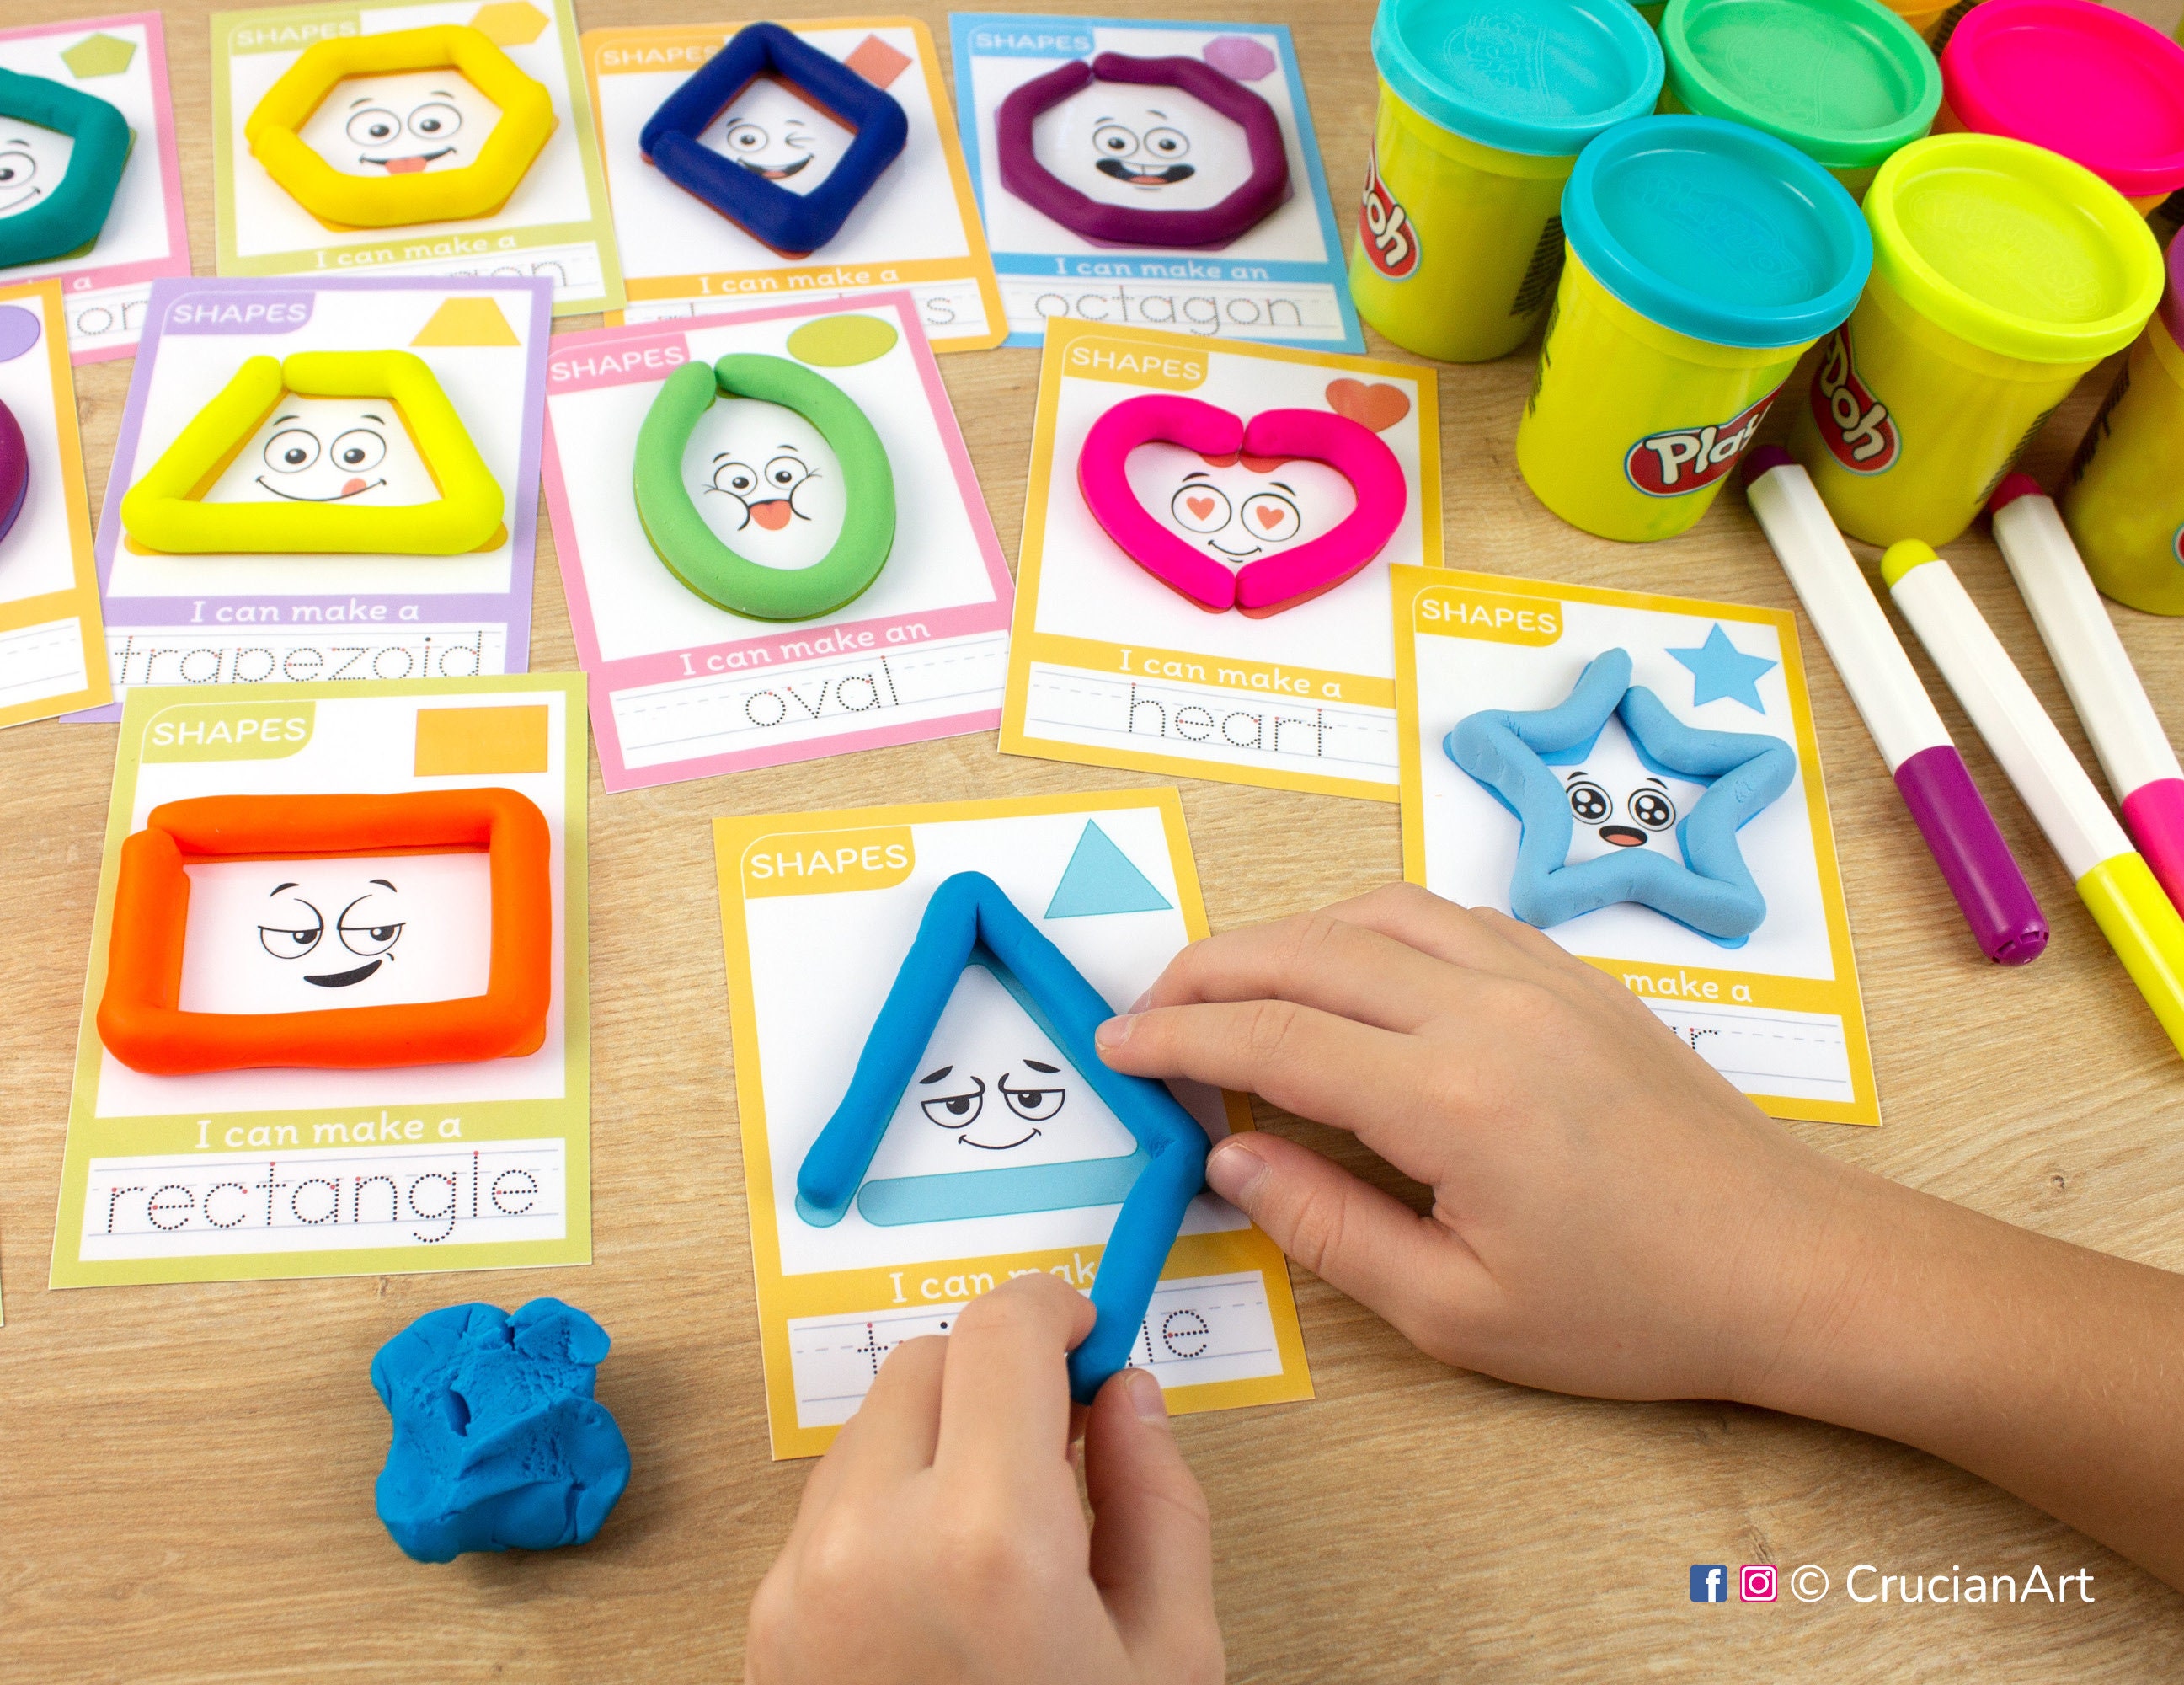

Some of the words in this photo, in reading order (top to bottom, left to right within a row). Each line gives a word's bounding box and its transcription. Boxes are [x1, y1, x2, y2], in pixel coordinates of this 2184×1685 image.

[237, 20, 357, 46] SHAPES
[975, 32, 1091, 51] SHAPES
[315, 251, 328, 270] I
[338, 247, 395, 265] can
[404, 236, 489, 260] make
[498, 234, 517, 249] a
[1056, 257, 1069, 275] I
[1076, 260, 1132, 276] can
[1140, 259, 1222, 279] make
[1231, 266, 1270, 280] an
[700, 275, 711, 295] I
[722, 273, 779, 292] can
[788, 268, 871, 289] make
[880, 269, 900, 283] a
[172, 302, 307, 324] SHAPES
[1035, 285, 1302, 336] octagon
[550, 346, 686, 381] SHAPES
[1071, 346, 1202, 381] SHAPES
[190, 601, 205, 623] I
[217, 604, 290, 623] can
[294, 597, 391, 623] make
[399, 603, 420, 621] a
[1420, 597, 1558, 634] SHAPES
[114, 630, 483, 684] trapezoid
[680, 653, 697, 677] I
[706, 645, 772, 672] can
[779, 627, 875, 661] make
[885, 622, 932, 645] an
[745, 655, 900, 727] oval
[1119, 648, 1134, 672] I
[1144, 657, 1207, 682] can
[1218, 665, 1311, 695] make
[1322, 681, 1343, 700] a
[151, 717, 307, 746] SHAPES
[1129, 682, 1333, 757] heart
[750, 843, 910, 880] SHAPES
[1622, 970, 1720, 1000] make
[1731, 983, 1753, 1003] a
[195, 1120, 211, 1150] I
[224, 1121, 300, 1148] can
[313, 1110, 425, 1144] make
[438, 1117, 462, 1138] a
[106, 1149, 540, 1244] rectangle
[889, 1271, 908, 1304] I
[920, 1271, 995, 1297] can
